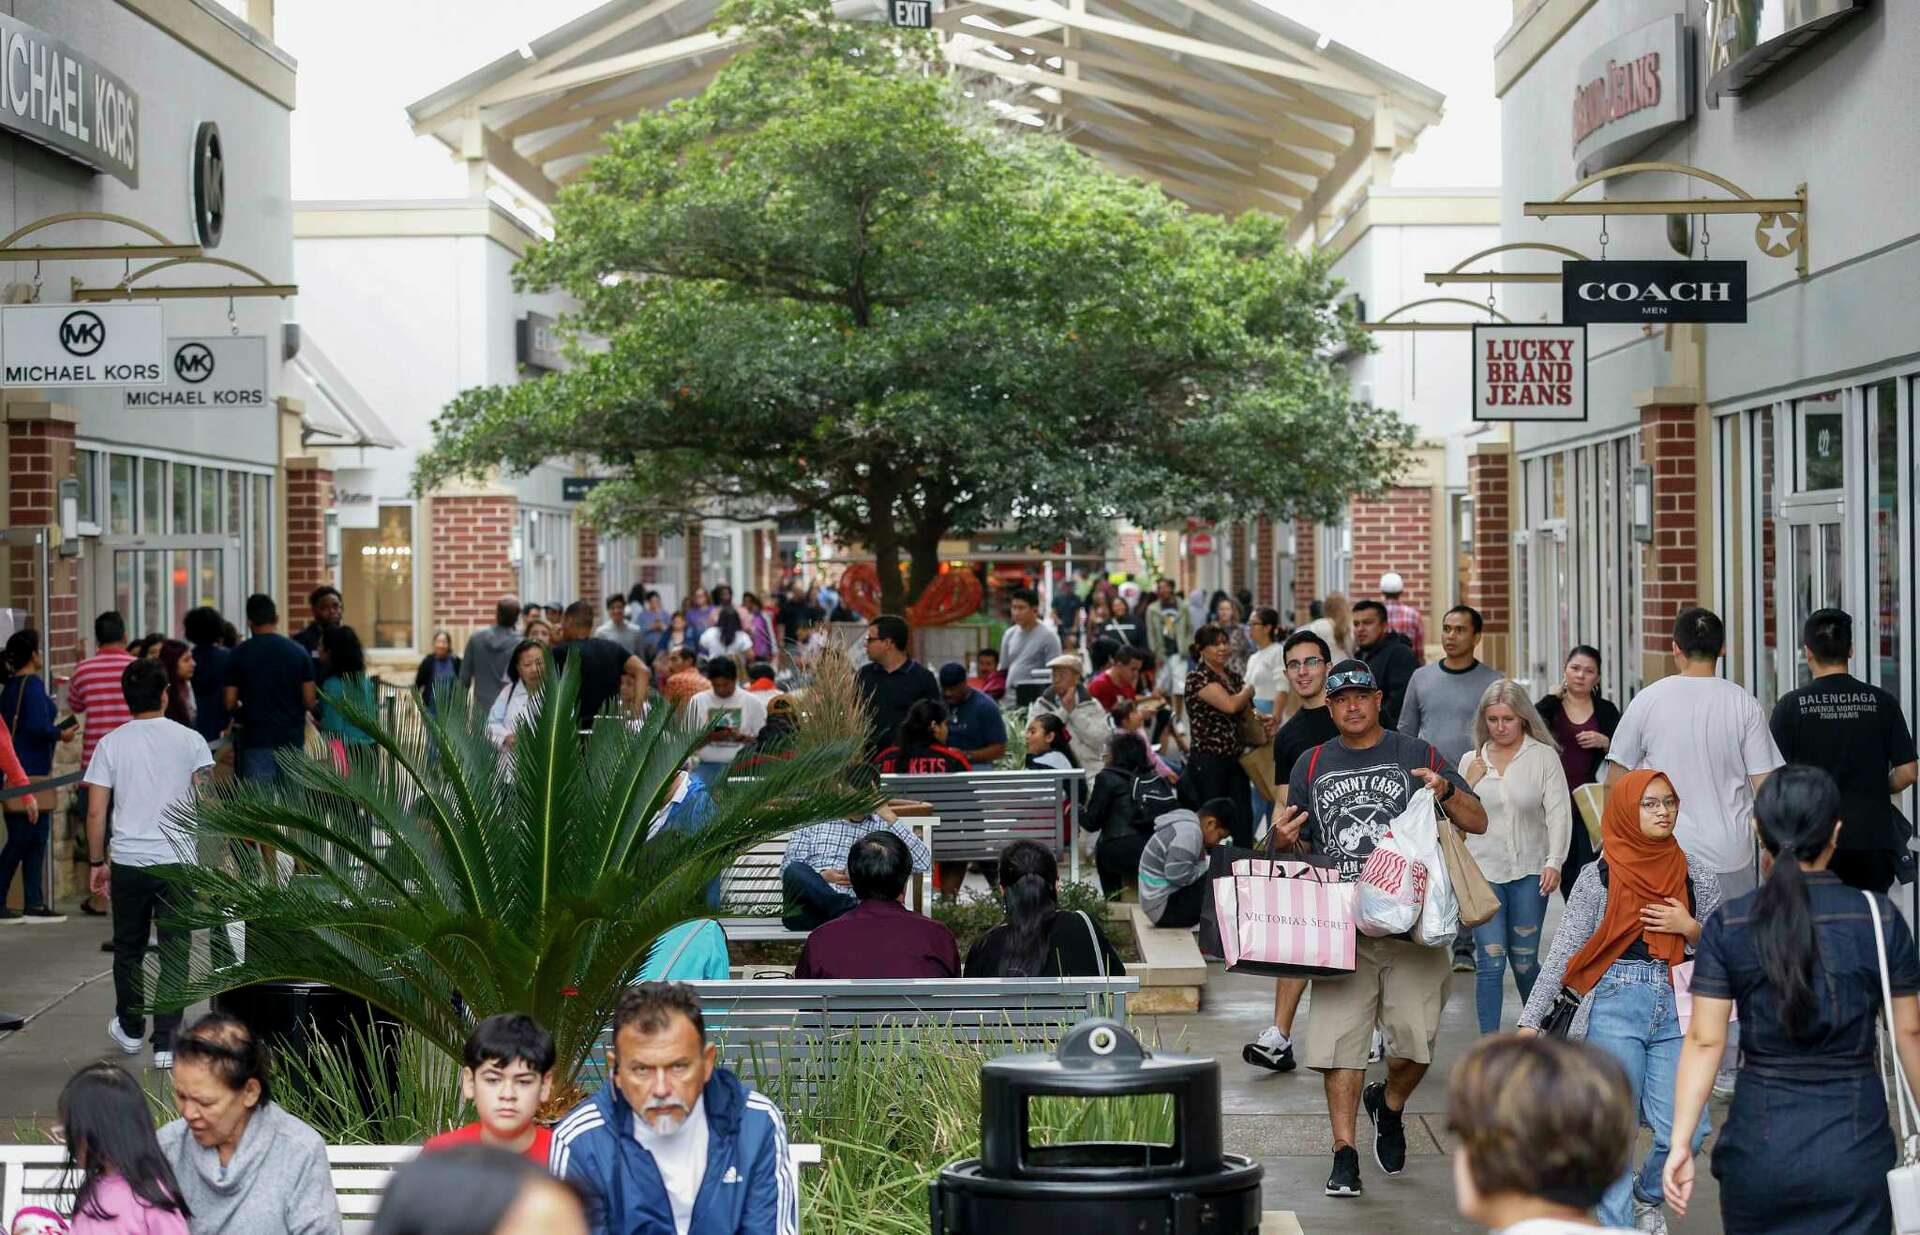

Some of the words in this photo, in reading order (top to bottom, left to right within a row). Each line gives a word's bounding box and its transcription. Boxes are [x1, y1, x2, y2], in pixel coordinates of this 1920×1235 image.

[895, 1, 928, 27] EXIT
[1606, 52, 1661, 122] JEANS
[0, 27, 89, 143] ICHAEL
[95, 73, 134, 170] KORS
[1578, 282, 1731, 301] COACH
[1486, 340, 1575, 361] LUCKY
[6, 366, 96, 382] MICHAEL
[104, 364, 160, 380] KORS
[1486, 363, 1573, 383] BRAND
[127, 391, 207, 406] MICHAEL
[213, 390, 263, 404] KORS
[1486, 385, 1572, 406] JEANS
[1799, 693, 1877, 706] BALENCIAGA
[1809, 705, 1835, 713] AVENUE
[1320, 776, 1368, 809] JOHNNY
[1370, 776, 1404, 800] CASH
